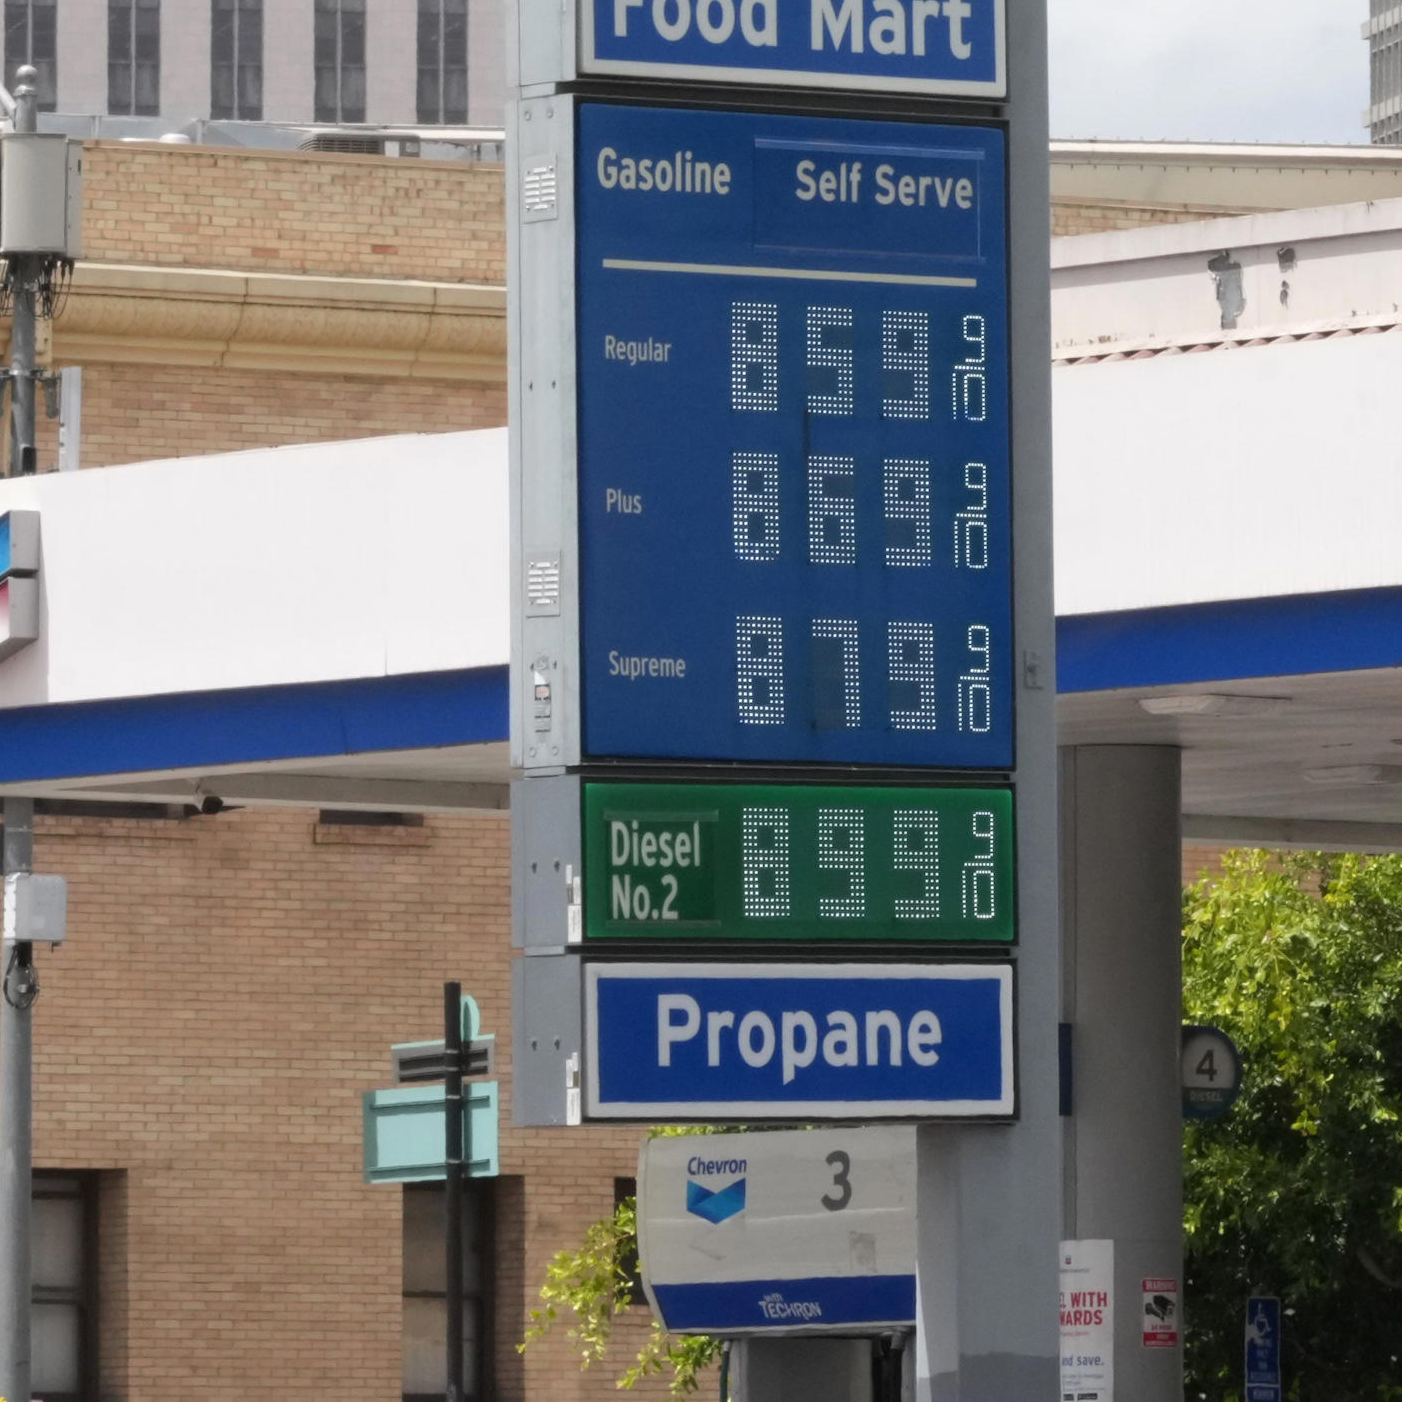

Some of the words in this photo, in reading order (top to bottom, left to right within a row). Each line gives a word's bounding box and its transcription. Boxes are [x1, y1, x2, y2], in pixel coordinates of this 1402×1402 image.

[597, 146, 731, 195] Gasoline
[795, 160, 862, 203] Self
[874, 164, 973, 209] Serve
[604, 334, 672, 367] Regular
[731, 301, 929, 419] 859
[606, 487, 643, 514] Plus
[732, 452, 932, 567] 869
[608, 650, 686, 681] Supreme
[736, 616, 937, 730] 879
[611, 819, 701, 867] Diesel
[742, 807, 940, 919] 899
[611, 873, 679, 921] No.2
[656, 993, 943, 1085] Propane
[1195, 1049, 1218, 1082] 4
[687, 1156, 748, 1176] Chevron
[820, 1150, 853, 1212] 3
[757, 1300, 822, 1321] TECHRON
[1070, 1292, 1107, 1308] WITH
[1077, 1356, 1104, 1366] save.
